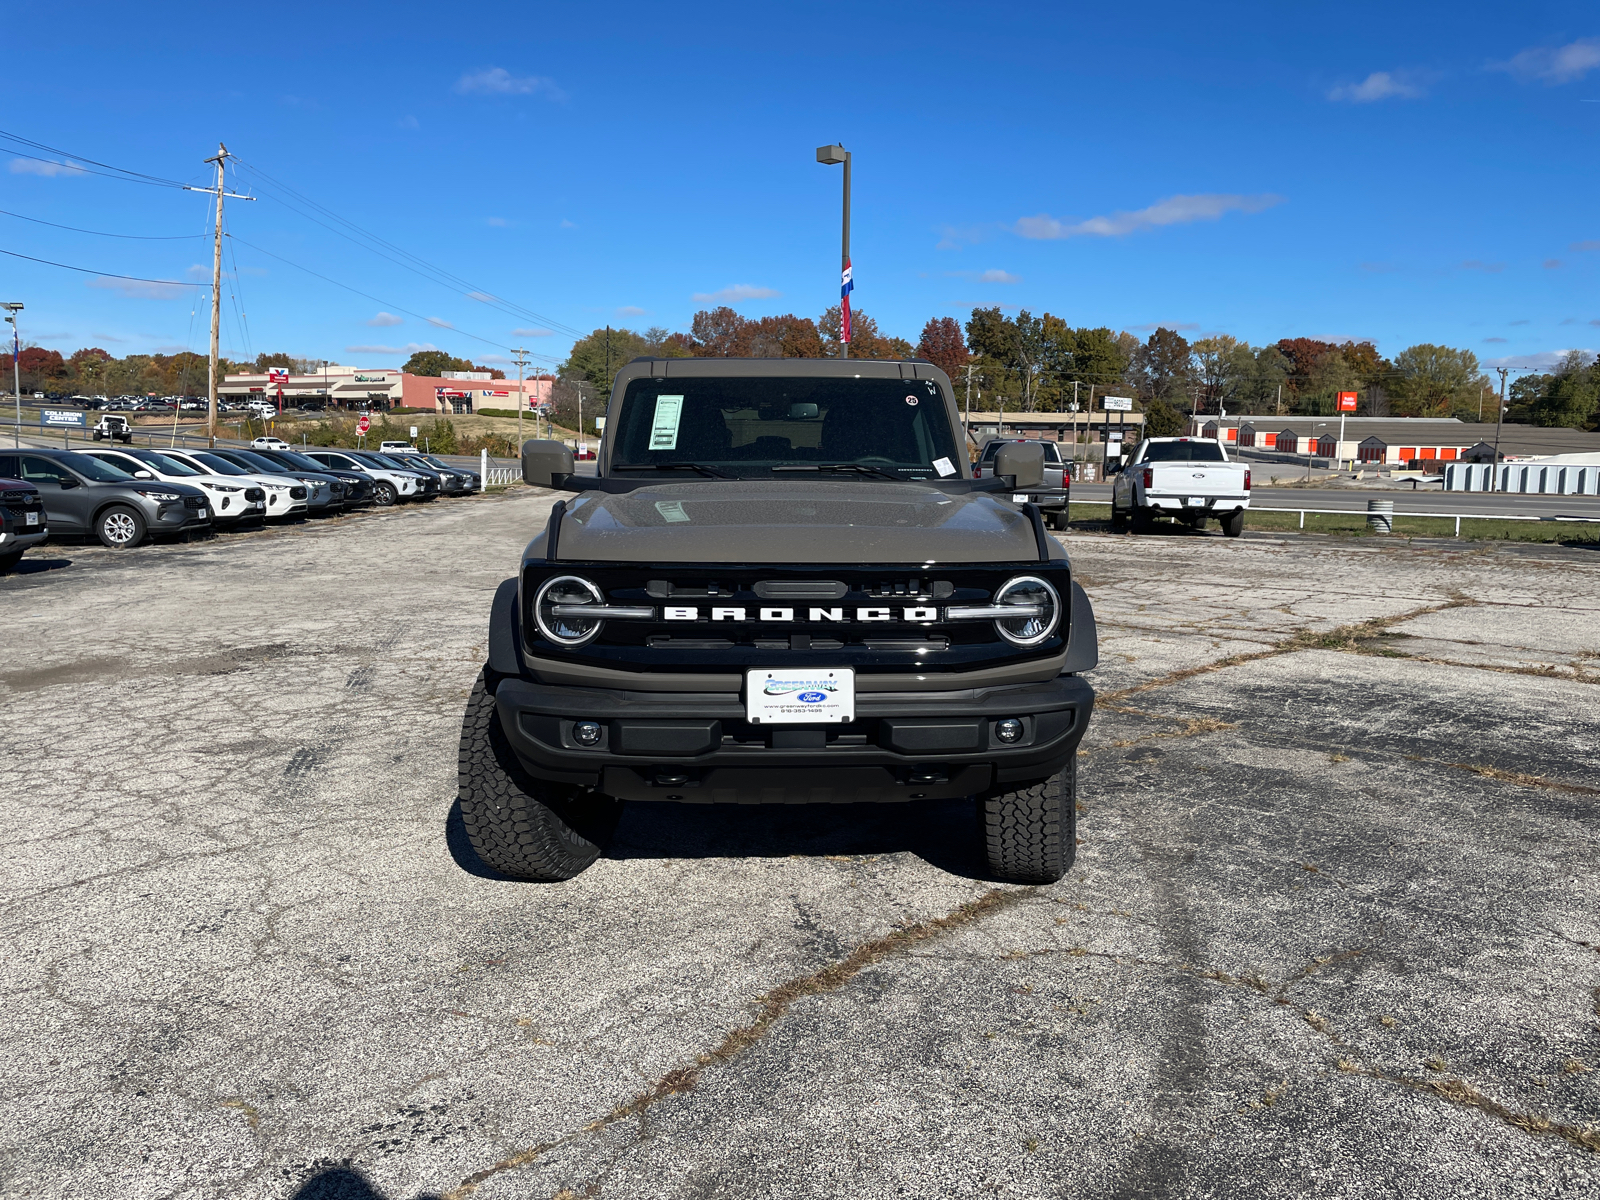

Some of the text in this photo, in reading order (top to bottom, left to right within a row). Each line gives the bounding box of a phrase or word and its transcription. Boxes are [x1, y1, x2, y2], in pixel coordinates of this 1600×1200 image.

[907, 396, 917, 404] 25
[664, 606, 938, 621] BRONCO
[764, 679, 838, 691] GREENWAY
[802, 692, 822, 702] Ford
